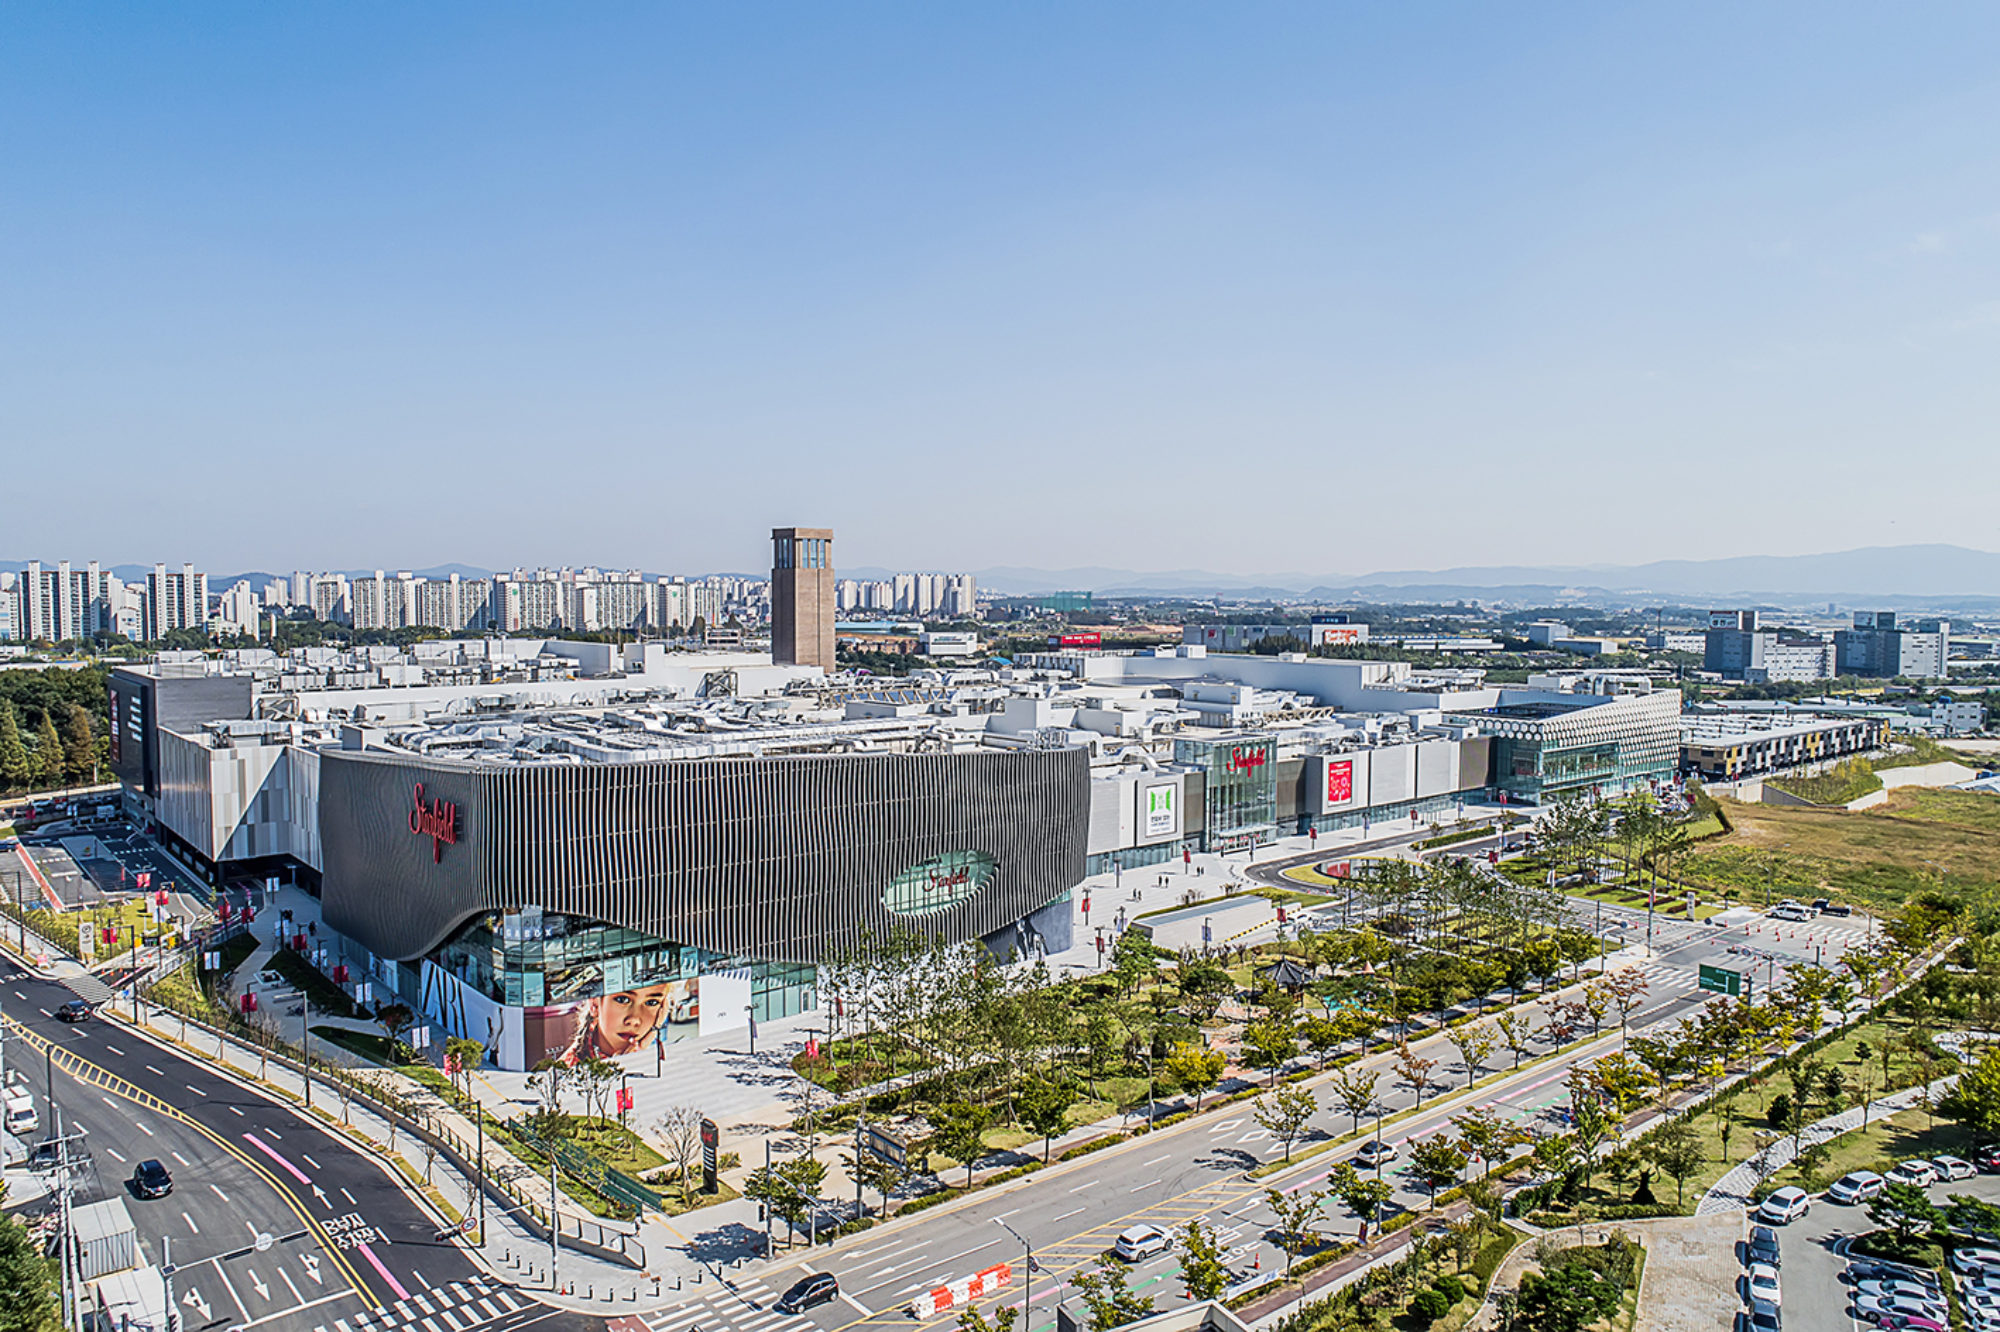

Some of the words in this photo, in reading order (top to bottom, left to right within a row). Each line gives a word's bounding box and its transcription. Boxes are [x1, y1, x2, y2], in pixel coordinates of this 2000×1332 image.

[1226, 746, 1266, 778] Starfield
[407, 782, 456, 865] Starfield
[331, 1226, 378, 1250] 주차장
